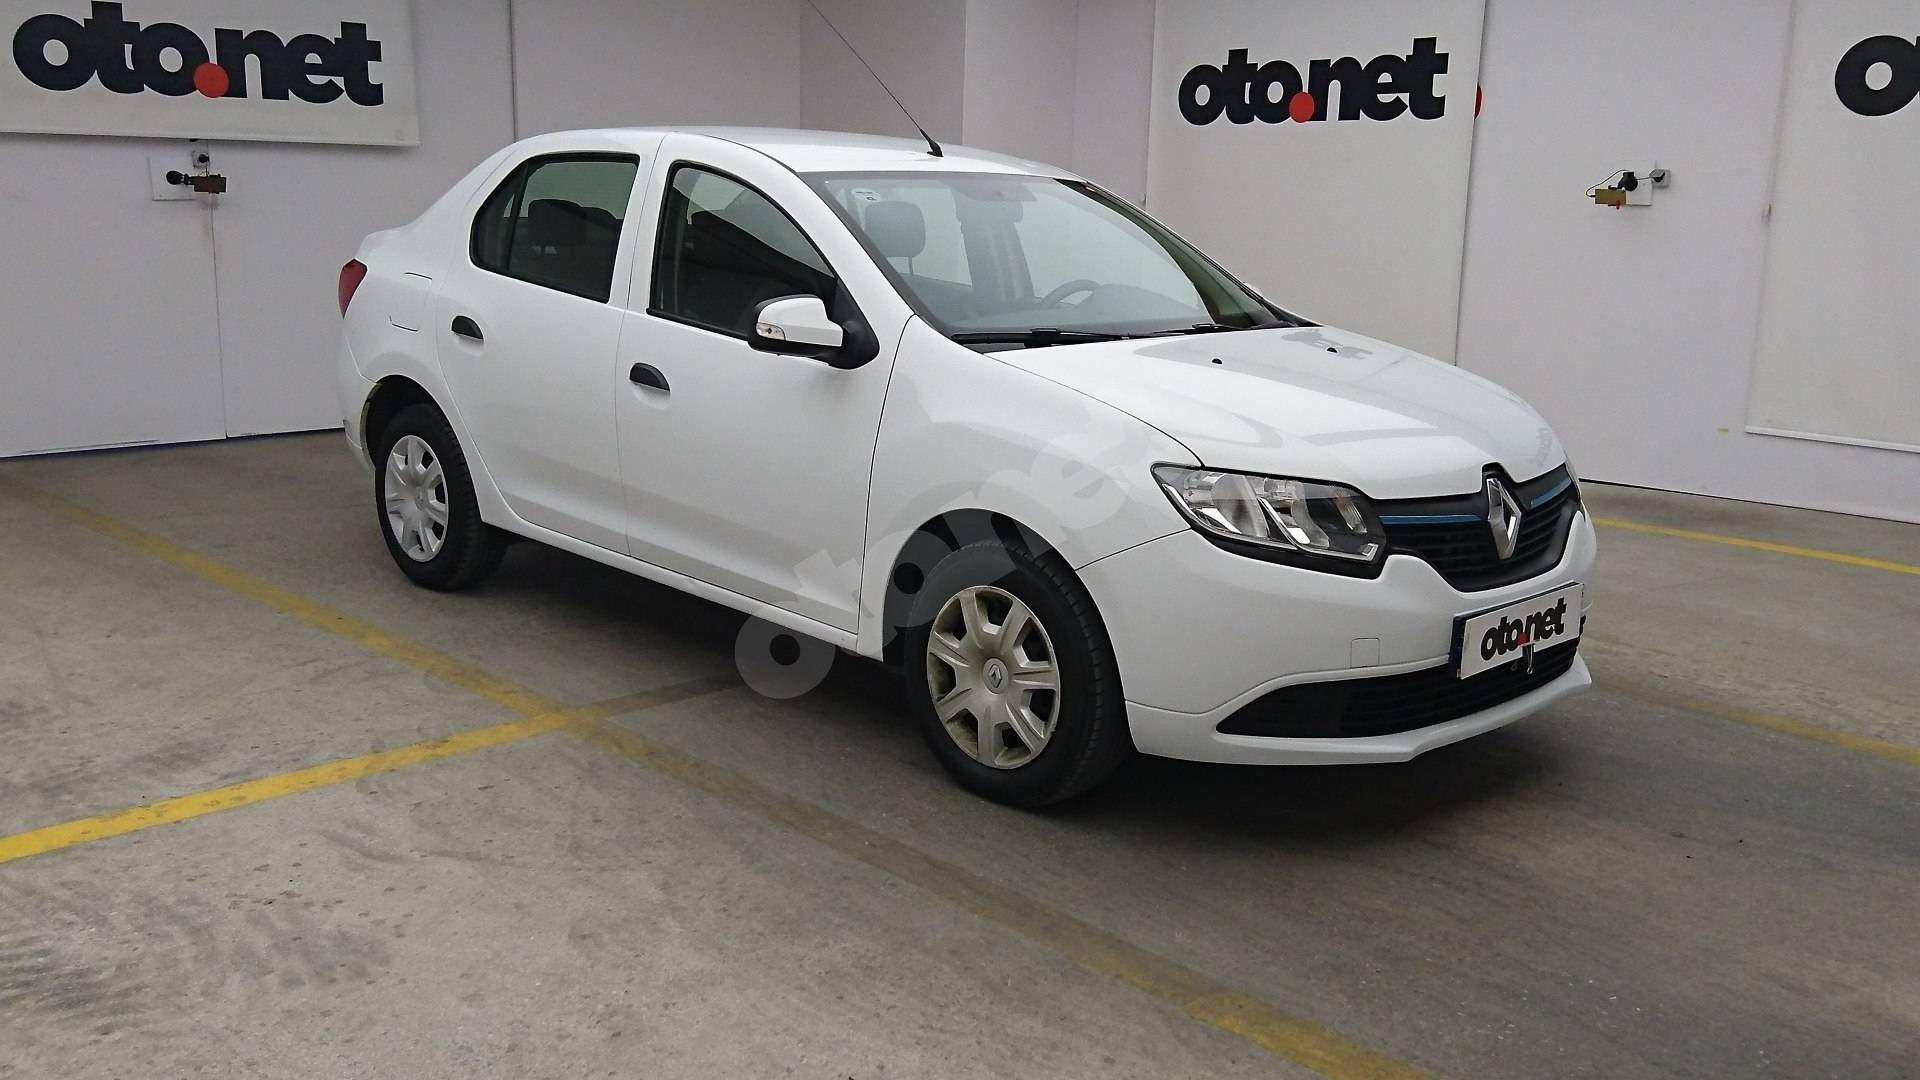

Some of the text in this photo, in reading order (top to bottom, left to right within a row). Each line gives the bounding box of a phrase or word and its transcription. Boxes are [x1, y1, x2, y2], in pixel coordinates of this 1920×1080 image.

[12, 0, 384, 107] oto.net
[1178, 36, 1449, 126] oto.net
[1834, 35, 1920, 117] o
[1480, 597, 1567, 661] oto.net
